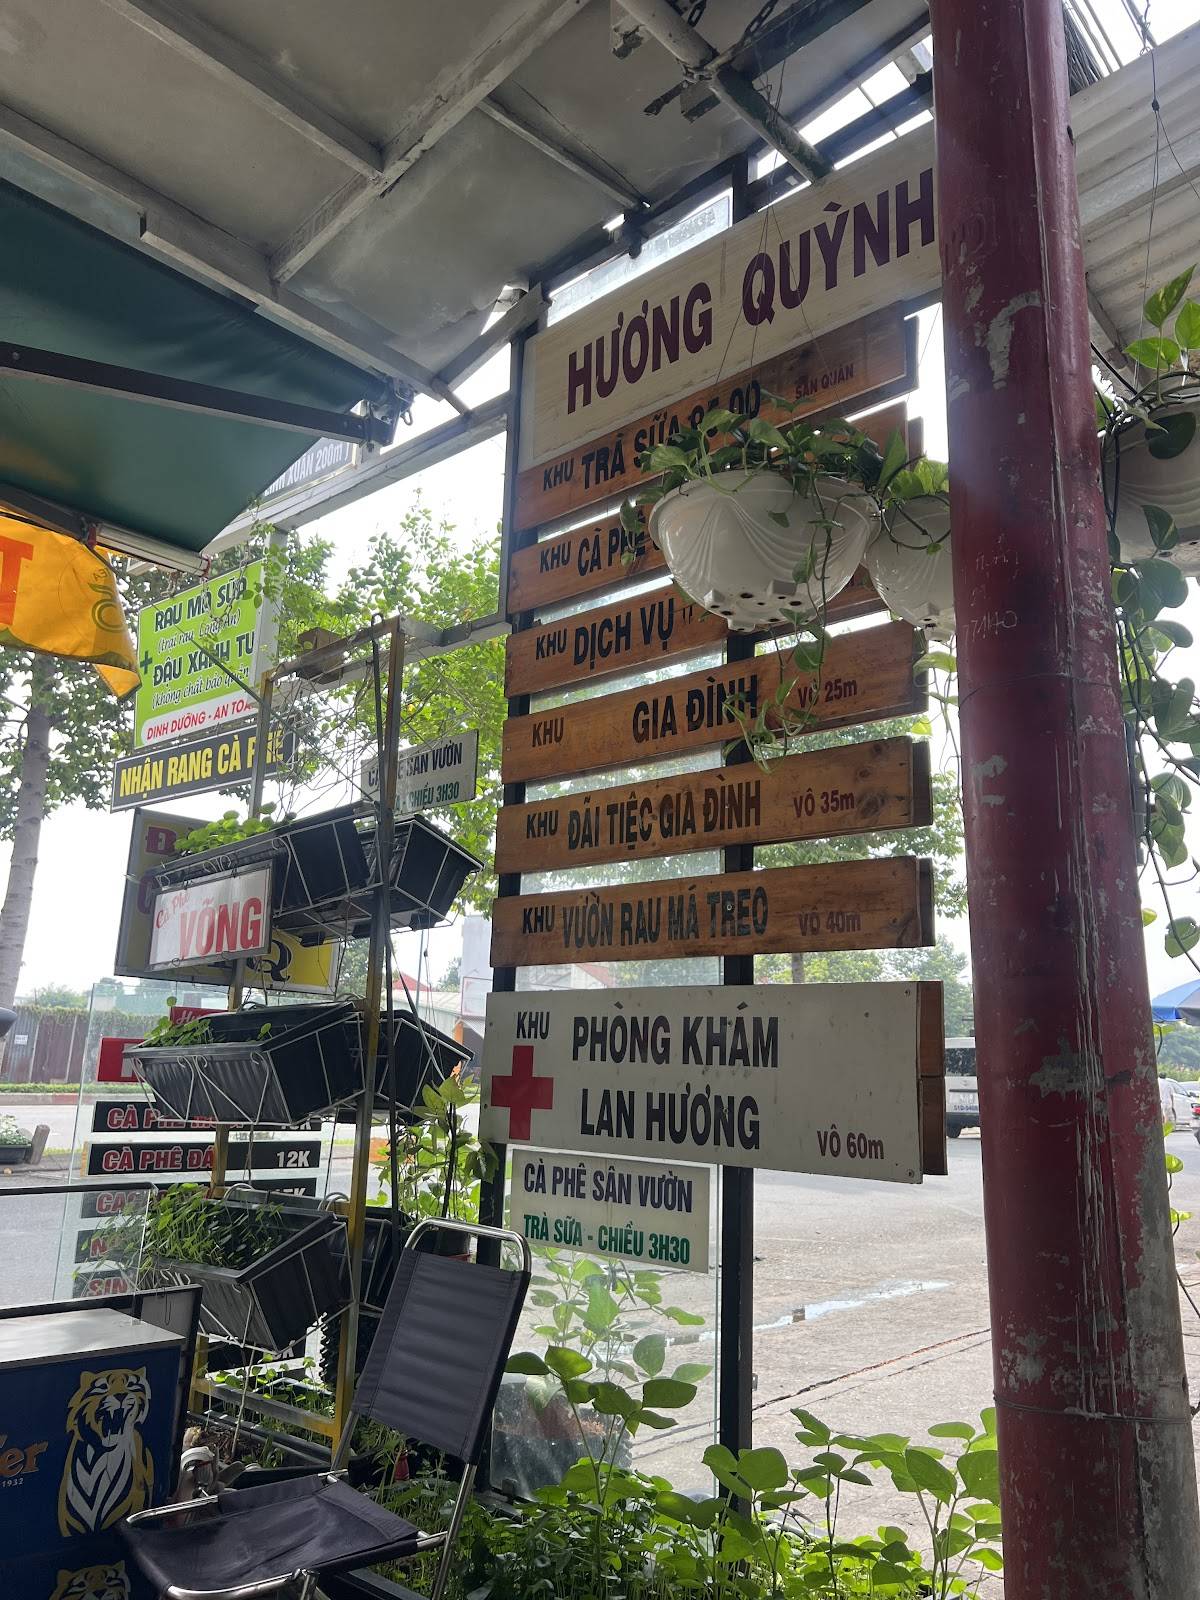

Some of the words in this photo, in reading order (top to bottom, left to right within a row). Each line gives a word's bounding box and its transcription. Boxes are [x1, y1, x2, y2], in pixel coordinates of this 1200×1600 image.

[567, 281, 712, 414] HƯƠNG
[741, 167, 935, 327] QUỲNH
[543, 458, 574, 491] KHU
[581, 432, 626, 490] TRÀ
[540, 541, 571, 573] KHU
[578, 528, 602, 576] CÀ
[155, 602, 182, 632] RAU
[536, 629, 567, 660] KHU
[573, 611, 631, 670] DỊCH
[640, 598, 674, 650] VỤ
[153, 656, 182, 687] ĐẬU
[825, 678, 858, 702] 25m
[147, 724, 168, 741] DINH
[213, 706, 229, 720] AN
[532, 718, 564, 748] KHU
[632, 694, 677, 744] GIA
[686, 674, 758, 733] ĐÌNH
[119, 757, 163, 799] NHẬN
[167, 747, 213, 786] RANG
[217, 735, 242, 775] CÀ
[436, 781, 460, 803] 3H30
[526, 809, 558, 839] KHU
[568, 796, 600, 850] ĐÃI
[606, 791, 652, 849] TIỆC
[659, 791, 696, 839] GIA
[703, 774, 761, 833] ĐÌNH
[793, 787, 815, 818] VÔ
[820, 790, 855, 814] 35m
[179, 897, 262, 960] VÕNG
[522, 904, 555, 934] KHU
[562, 891, 613, 948] VƯỜN
[620, 897, 661, 946] RAU
[668, 884, 699, 940] MÁ
[707, 886, 768, 938] TREO
[798, 905, 820, 936] VÔ
[826, 910, 861, 933] 40m
[516, 1011, 550, 1040] KHU
[572, 1001, 670, 1065] PHÒNG
[682, 1001, 779, 1068] KHÁM
[107, 1104, 137, 1129] CÀ
[580, 1088, 635, 1139] LAN
[646, 1082, 760, 1150] HƯƠNG
[102, 1146, 135, 1171] CÀ
[139, 1147, 183, 1170] PHÊ
[276, 1150, 311, 1168] 12K
[817, 1125, 840, 1158] VÔ
[846, 1131, 884, 1160] 60m
[524, 1158, 546, 1194] CÀ
[552, 1162, 586, 1199] PHÊ
[592, 1165, 632, 1205] SÂN
[638, 1170, 692, 1213] VƯỜN
[523, 1212, 549, 1241] TRÀ
[553, 1216, 582, 1246] SỮA
[598, 1220, 643, 1257] CHIỀU
[649, 1233, 690, 1264] 3H30
